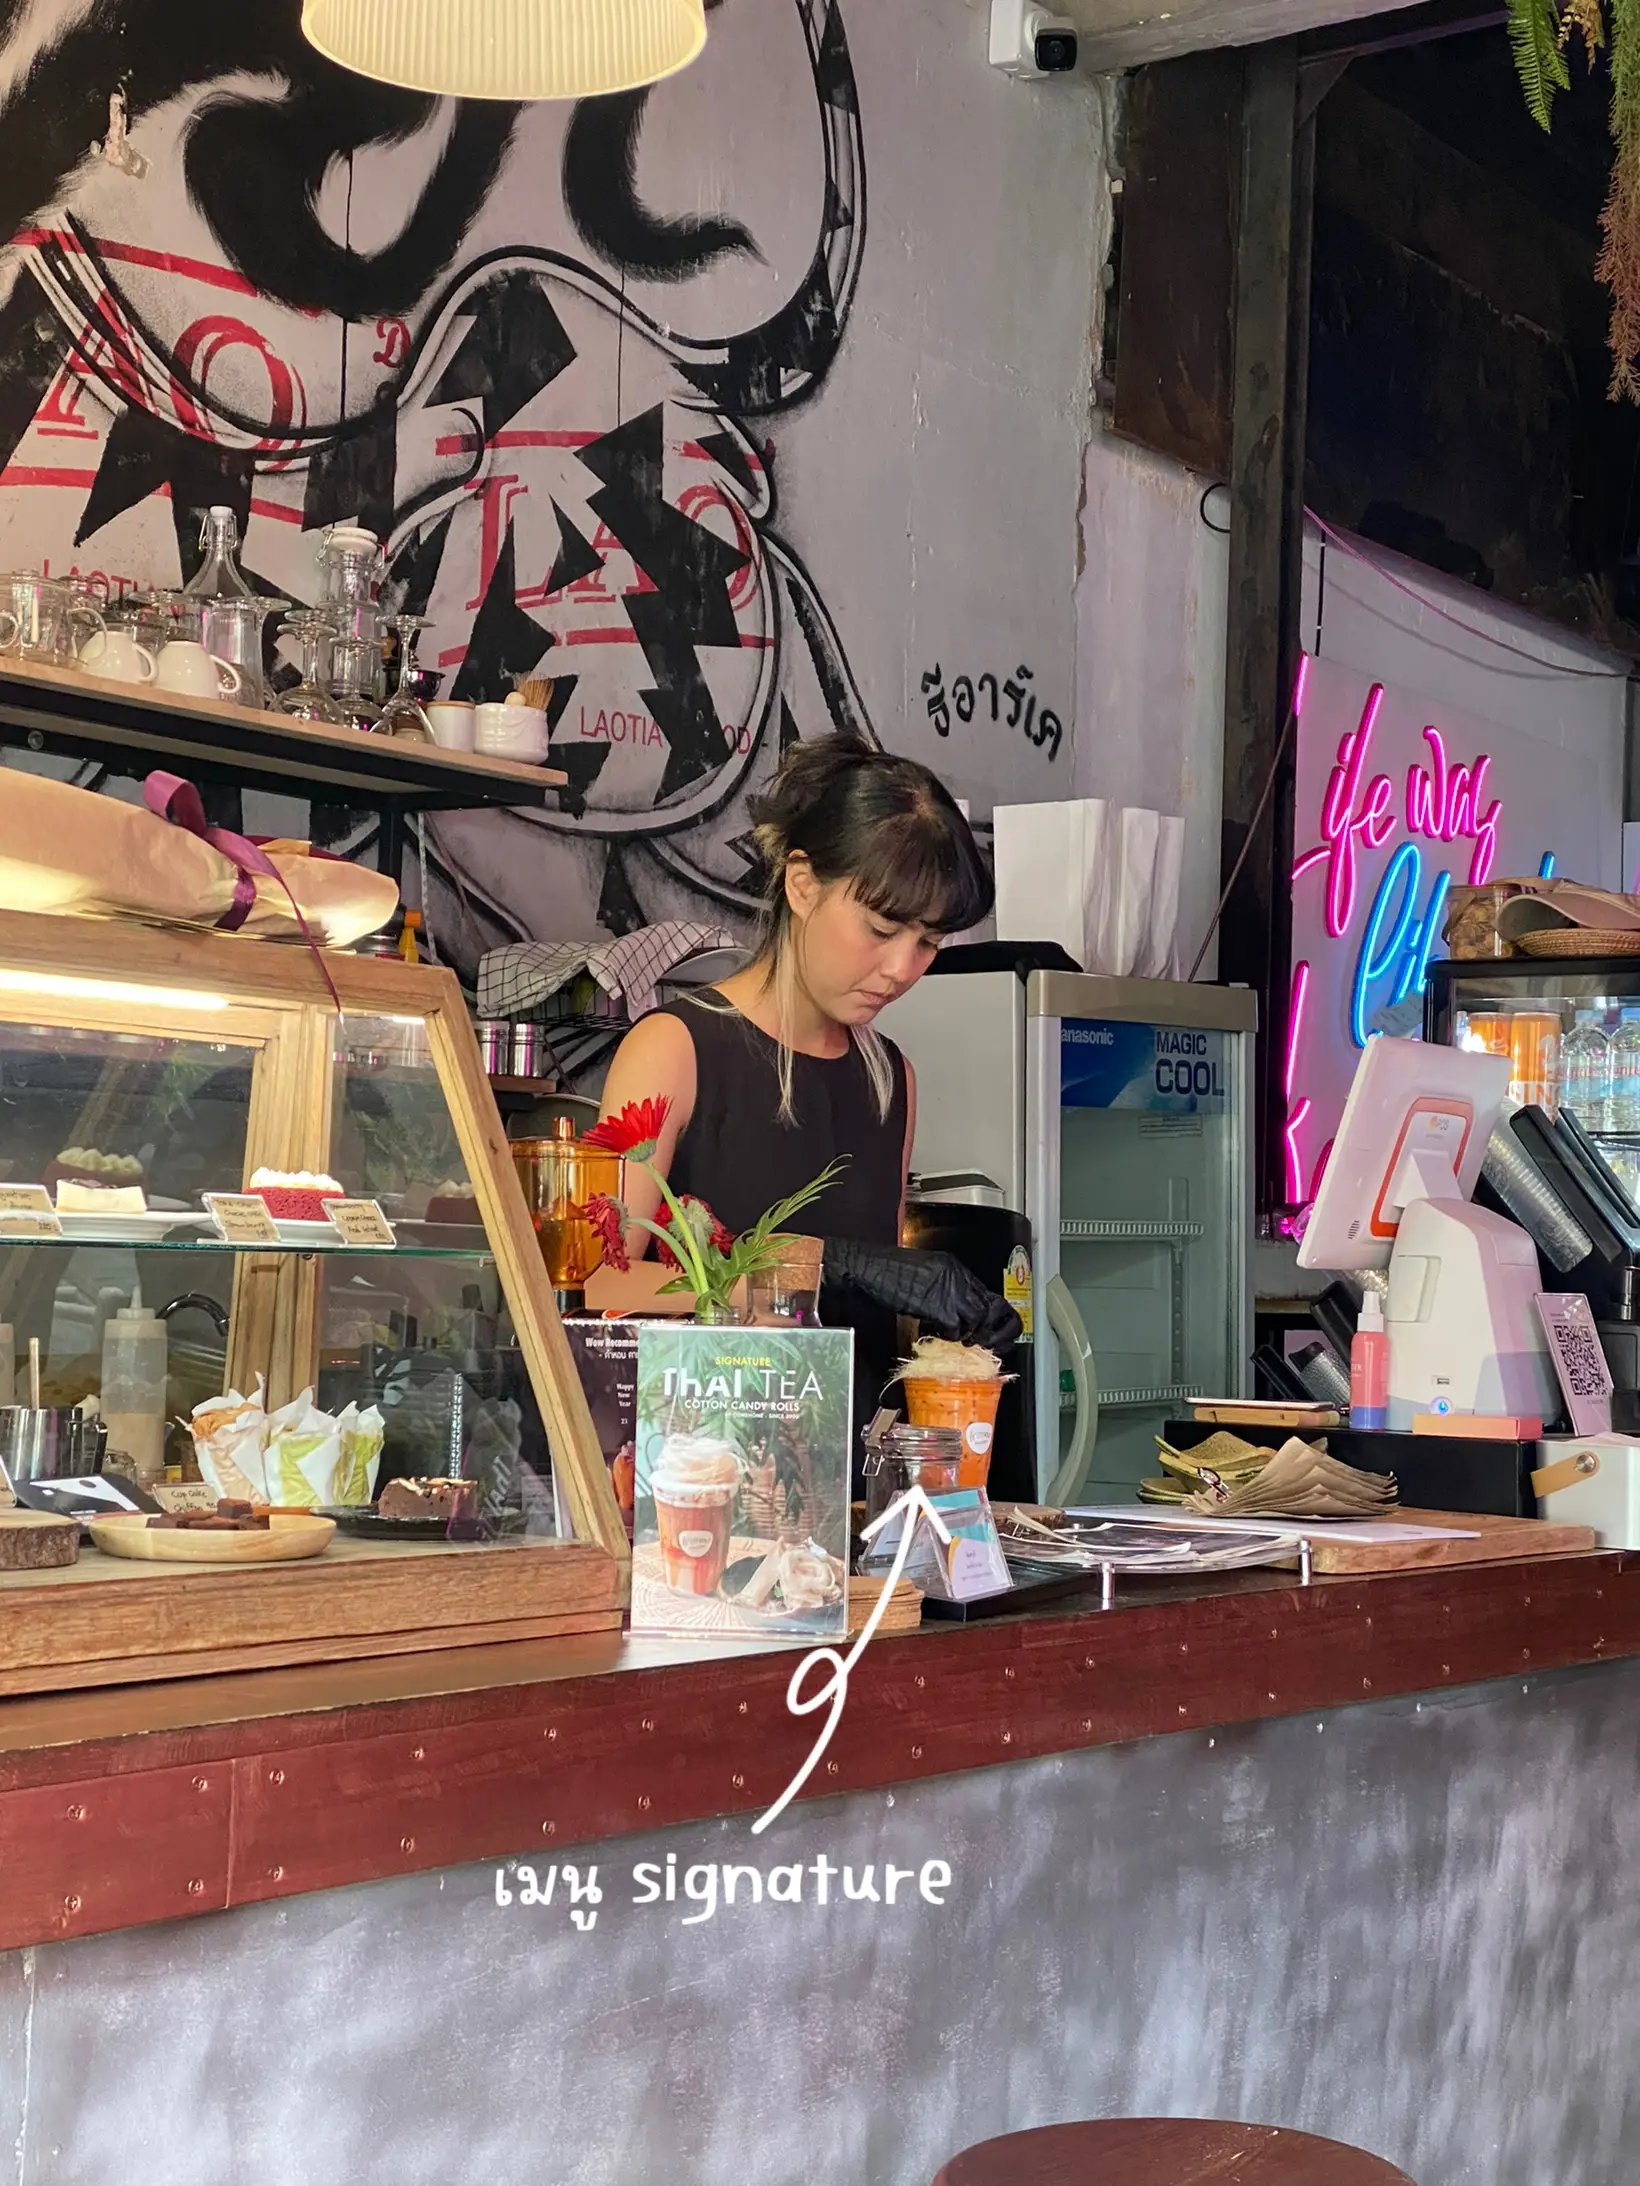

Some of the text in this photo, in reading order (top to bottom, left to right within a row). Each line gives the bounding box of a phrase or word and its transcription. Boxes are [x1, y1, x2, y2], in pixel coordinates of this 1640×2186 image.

[1156, 1031, 1207, 1056] MAGIC
[1156, 1058, 1225, 1096] COOL
[715, 1356, 771, 1368] SIGNATURE
[759, 1369, 824, 1401] TEA
[684, 1399, 800, 1413] COTTON CANDY ROLLS
